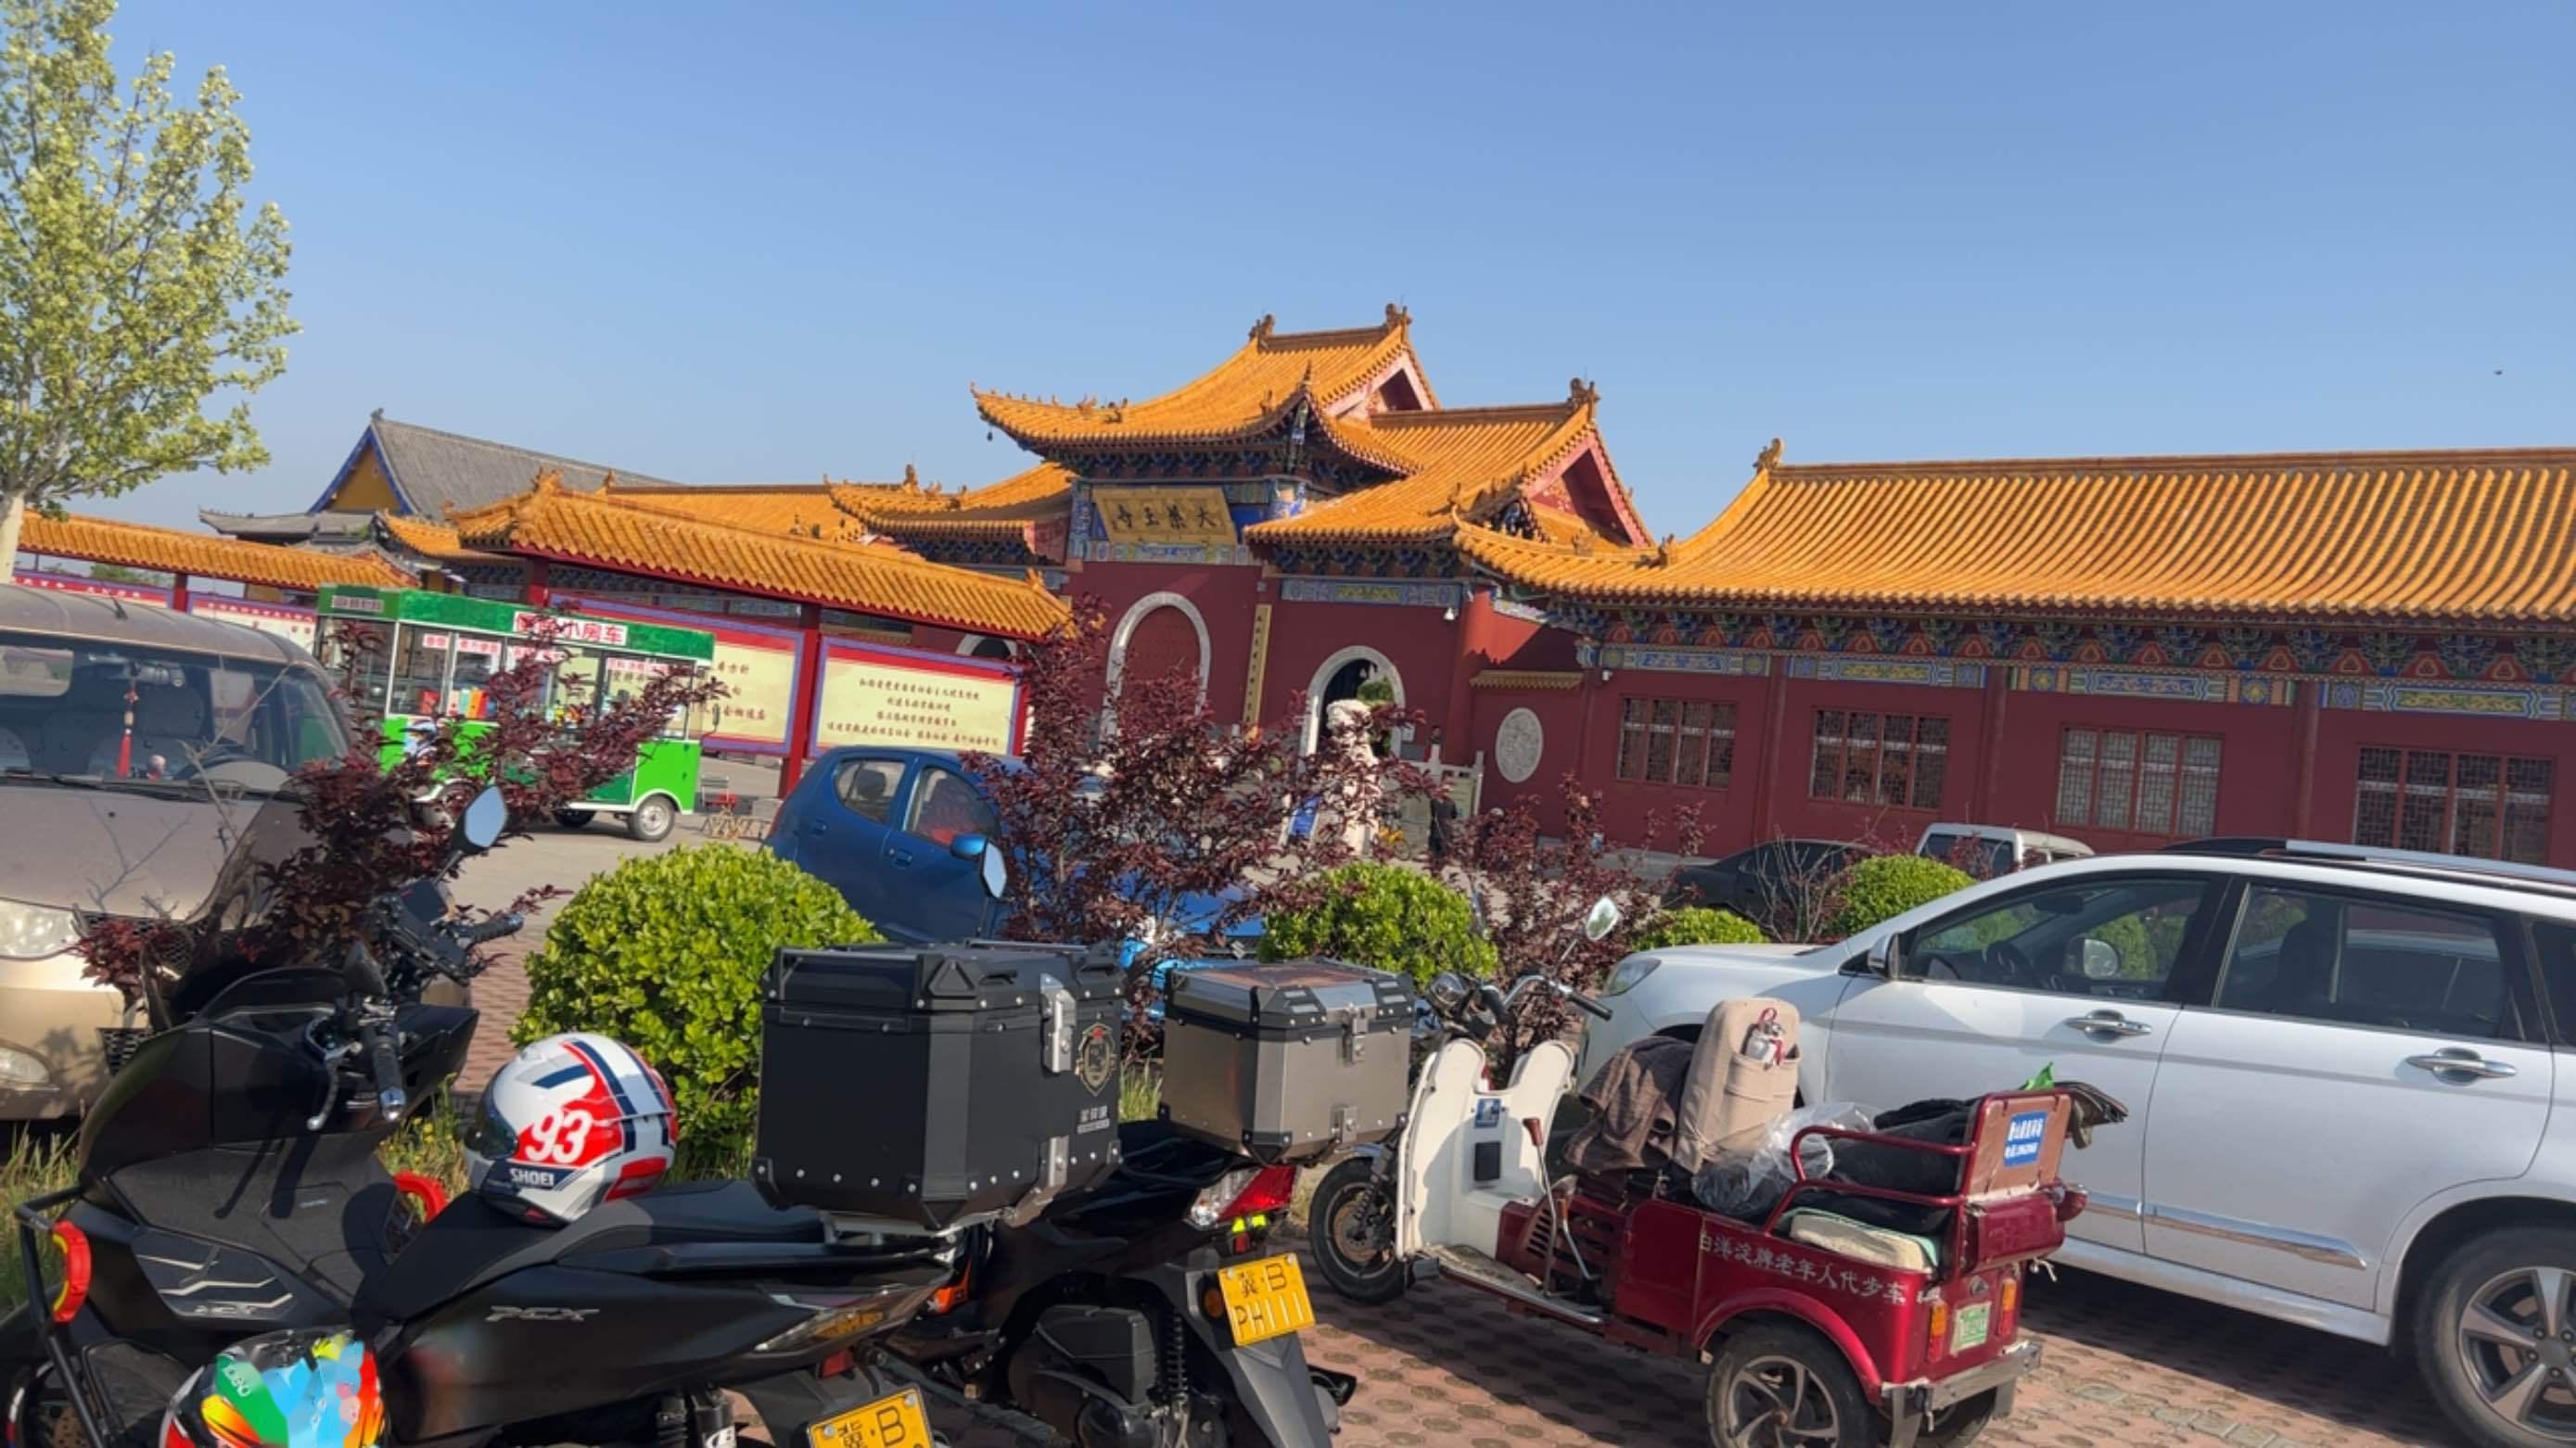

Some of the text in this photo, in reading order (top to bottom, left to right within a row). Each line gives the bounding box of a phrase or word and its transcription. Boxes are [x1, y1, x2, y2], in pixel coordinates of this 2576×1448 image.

[524, 1109, 593, 1164] 93
[509, 1168, 555, 1187] SHOEI
[1700, 1230, 1906, 1304] 白洋淀牌老年人代步车
